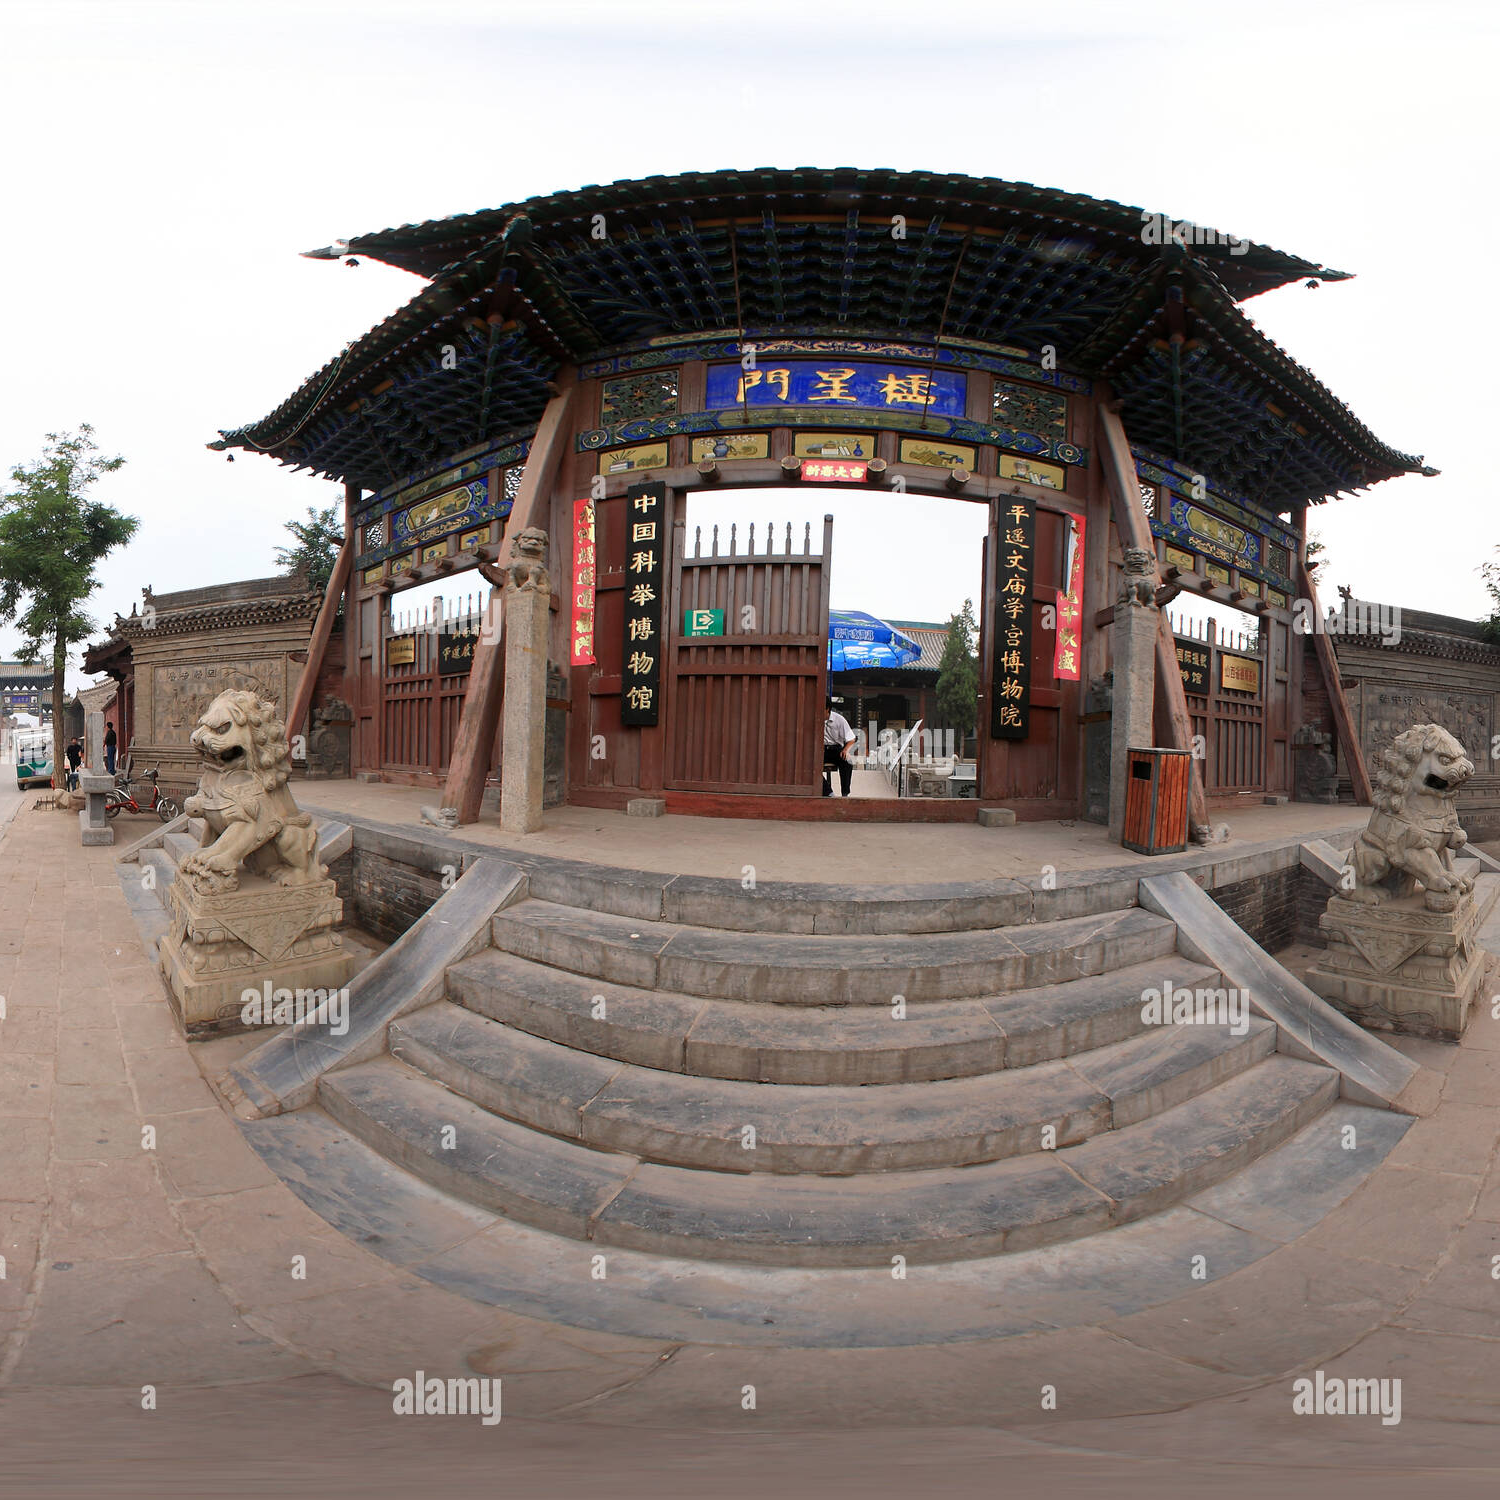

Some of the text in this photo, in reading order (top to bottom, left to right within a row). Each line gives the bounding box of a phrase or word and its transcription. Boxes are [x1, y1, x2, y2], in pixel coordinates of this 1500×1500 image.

[805, 464, 865, 479] 新春大吉
[626, 494, 658, 710] 中国科举博物馆
[1000, 505, 1031, 727] 平遥文庙学宫博物院
